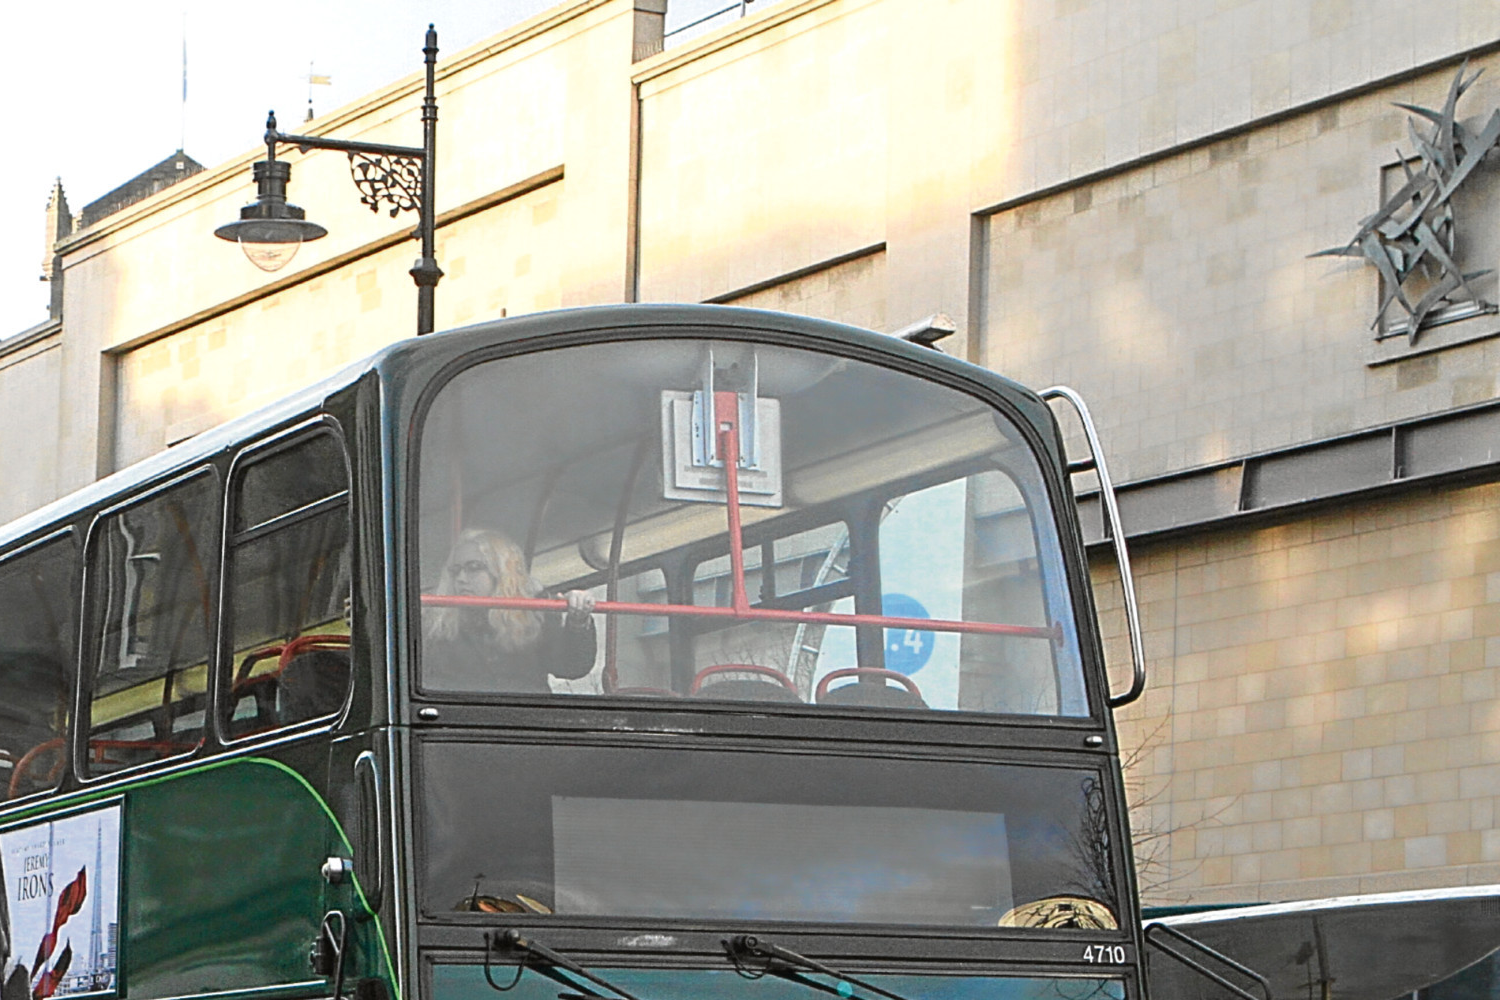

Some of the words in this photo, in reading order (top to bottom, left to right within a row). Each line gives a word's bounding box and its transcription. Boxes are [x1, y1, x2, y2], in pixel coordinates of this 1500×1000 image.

[23, 852, 49, 875] JEREMY
[17, 872, 55, 902] IRONS
[1082, 944, 1126, 964] 4710
